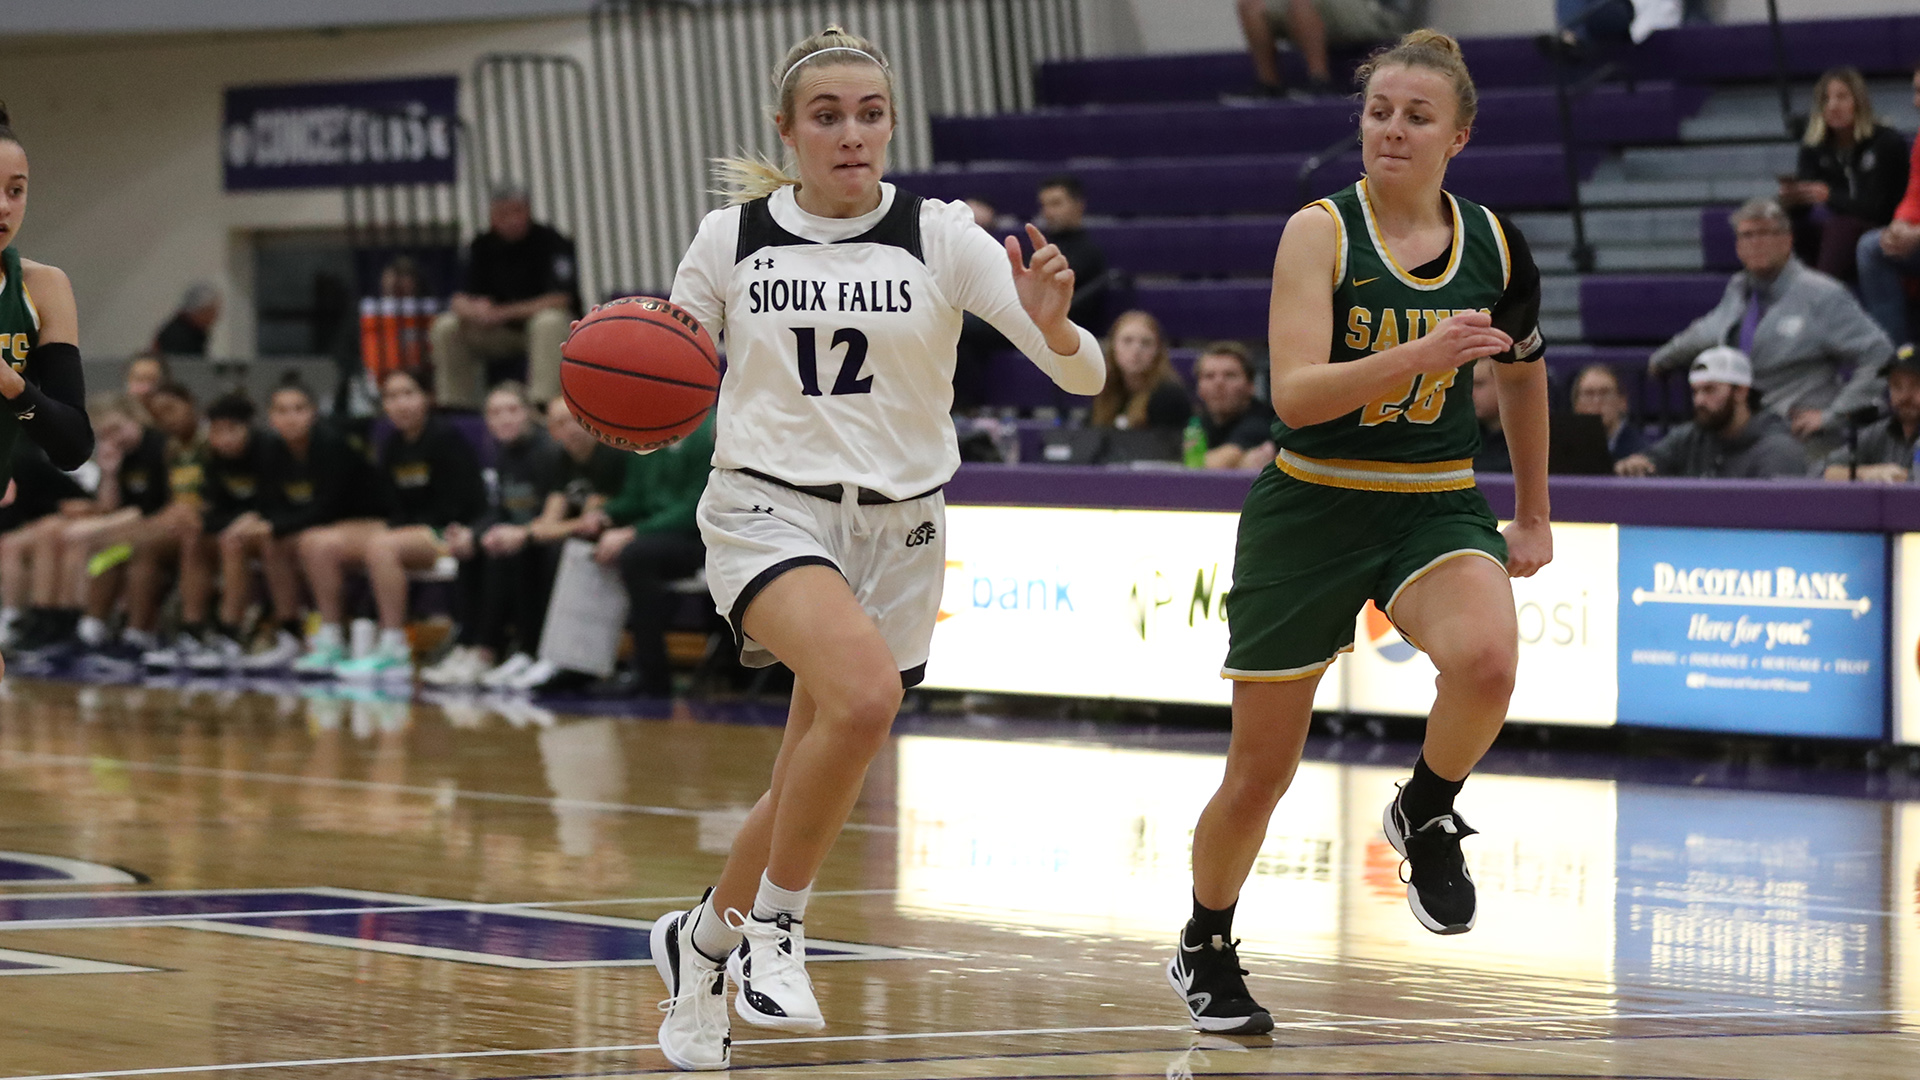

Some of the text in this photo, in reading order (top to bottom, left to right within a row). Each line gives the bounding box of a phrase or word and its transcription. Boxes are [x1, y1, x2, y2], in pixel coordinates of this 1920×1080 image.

[749, 279, 912, 314] SIOUX FALLS
[1344, 305, 1491, 352] SAIN
[788, 327, 874, 397] 12
[905, 529, 936, 548] USF
[971, 562, 1074, 612] bank
[1653, 562, 1848, 600] DACOTAH BANK
[1687, 613, 1734, 642] Here
[1730, 614, 1764, 648] for
